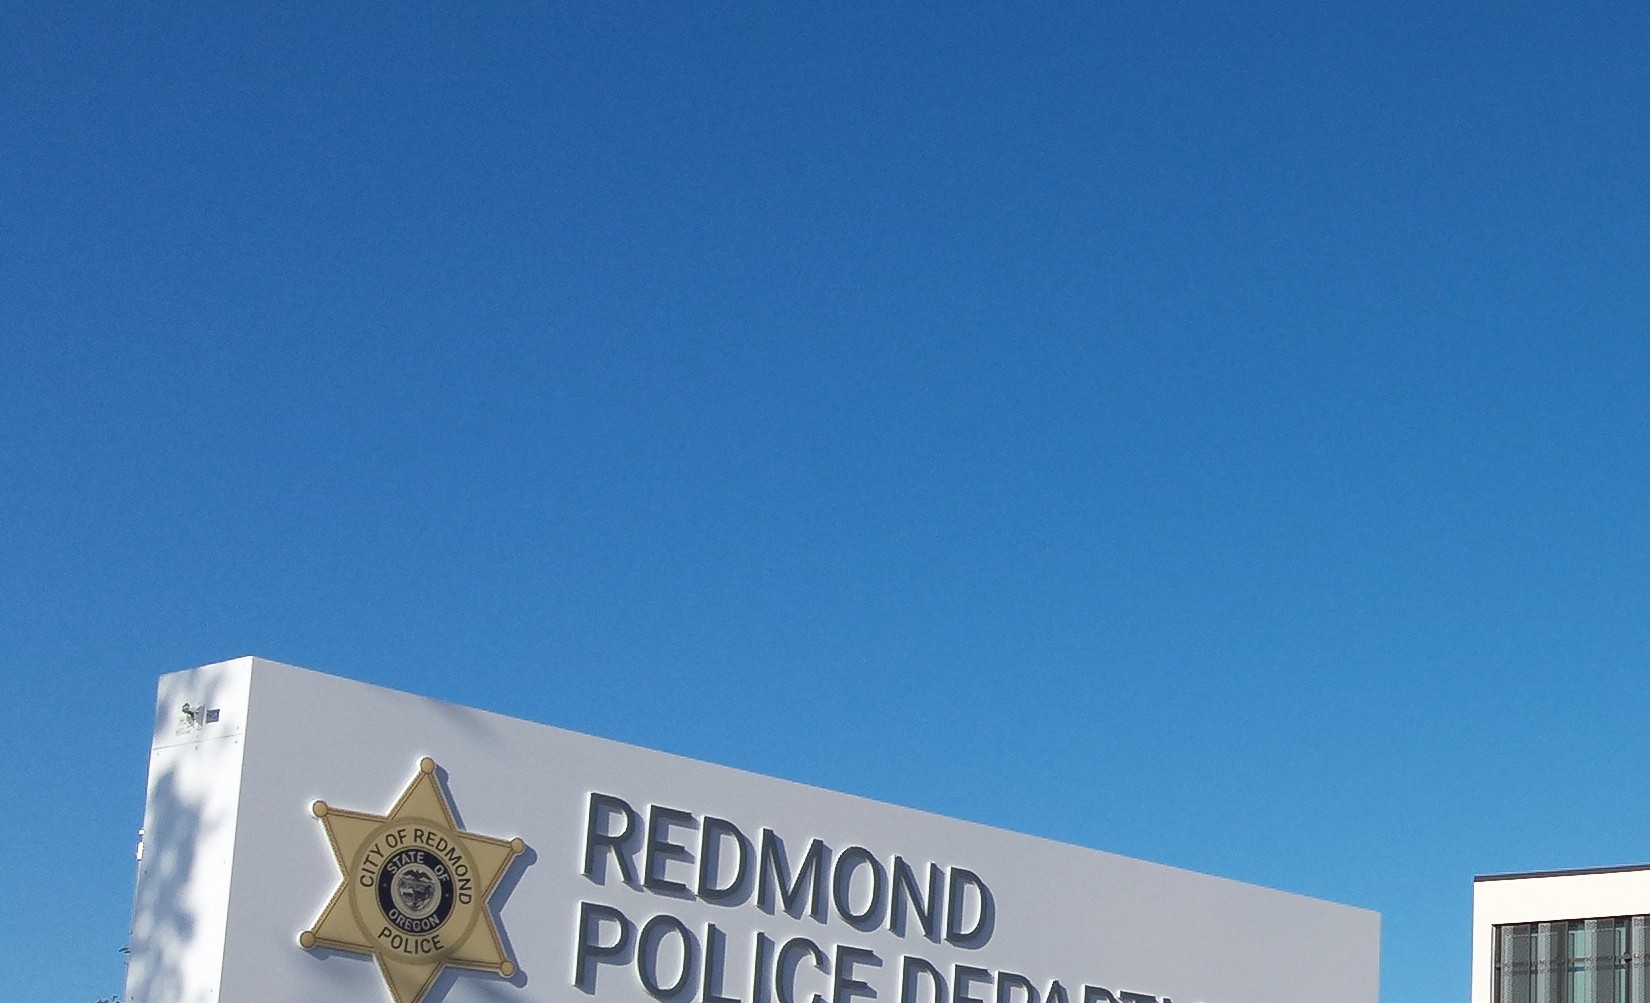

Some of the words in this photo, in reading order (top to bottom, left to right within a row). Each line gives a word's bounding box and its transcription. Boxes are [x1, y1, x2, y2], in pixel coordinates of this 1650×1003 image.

[359, 843, 385, 888] CITY
[385, 828, 408, 849] OF
[413, 828, 473, 906] REDMOND
[386, 850, 426, 875] STATE
[434, 863, 451, 883] OF
[582, 791, 991, 945] REDMOND
[388, 908, 440, 932] OREGON
[377, 926, 444, 955] POLICE
